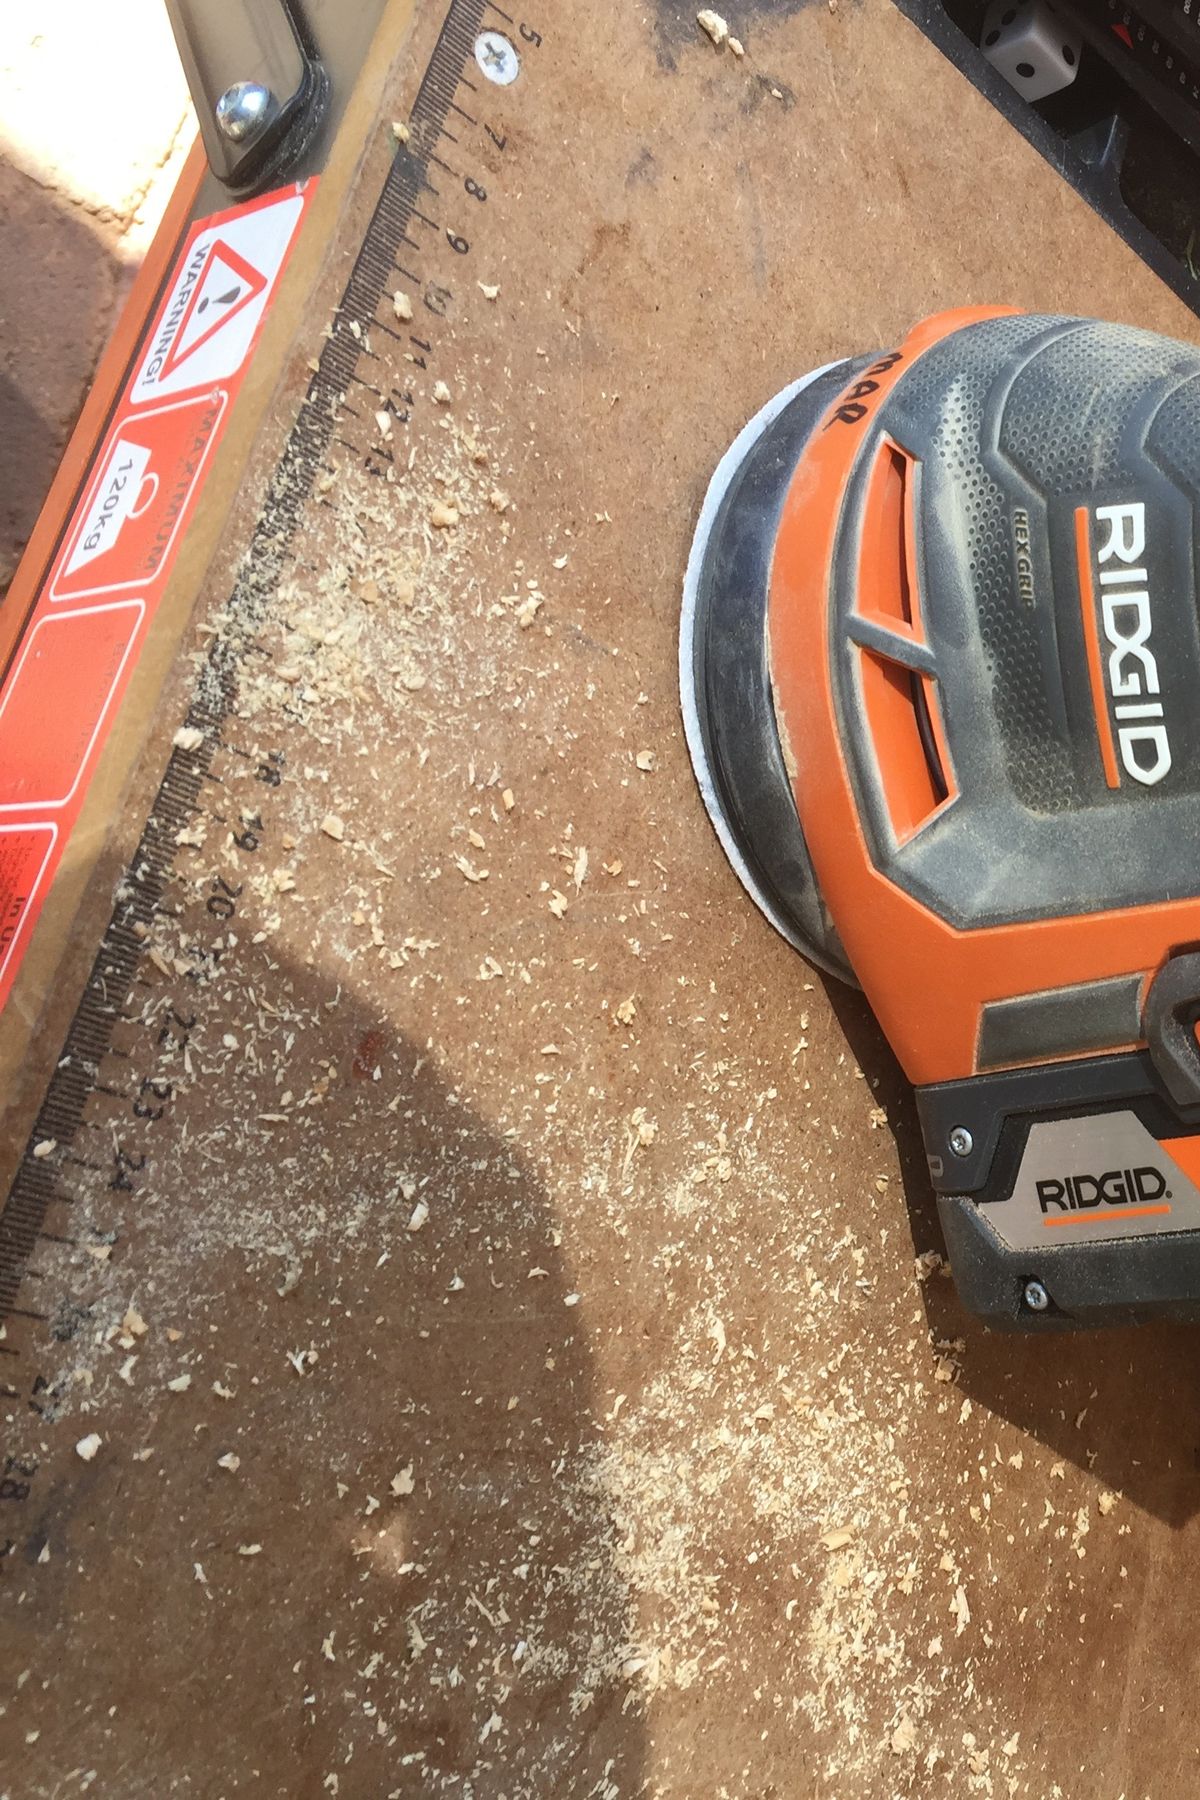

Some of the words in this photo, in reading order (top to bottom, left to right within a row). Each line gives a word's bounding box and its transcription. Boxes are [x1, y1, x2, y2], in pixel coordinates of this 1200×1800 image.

[519, 22, 542, 48] 5
[484, 123, 507, 150] 7
[464, 177, 488, 201] 8
[446, 228, 469, 255] 9
[142, 244, 211, 387] WARNING!
[83, 458, 134, 551] 120kg
[1013, 509, 1031, 551] HEX
[1016, 557, 1036, 613] GRIP
[1096, 502, 1172, 786] RIDGID
[207, 875, 243, 919] 20
[1036, 1166, 1167, 1213] RIDGID
